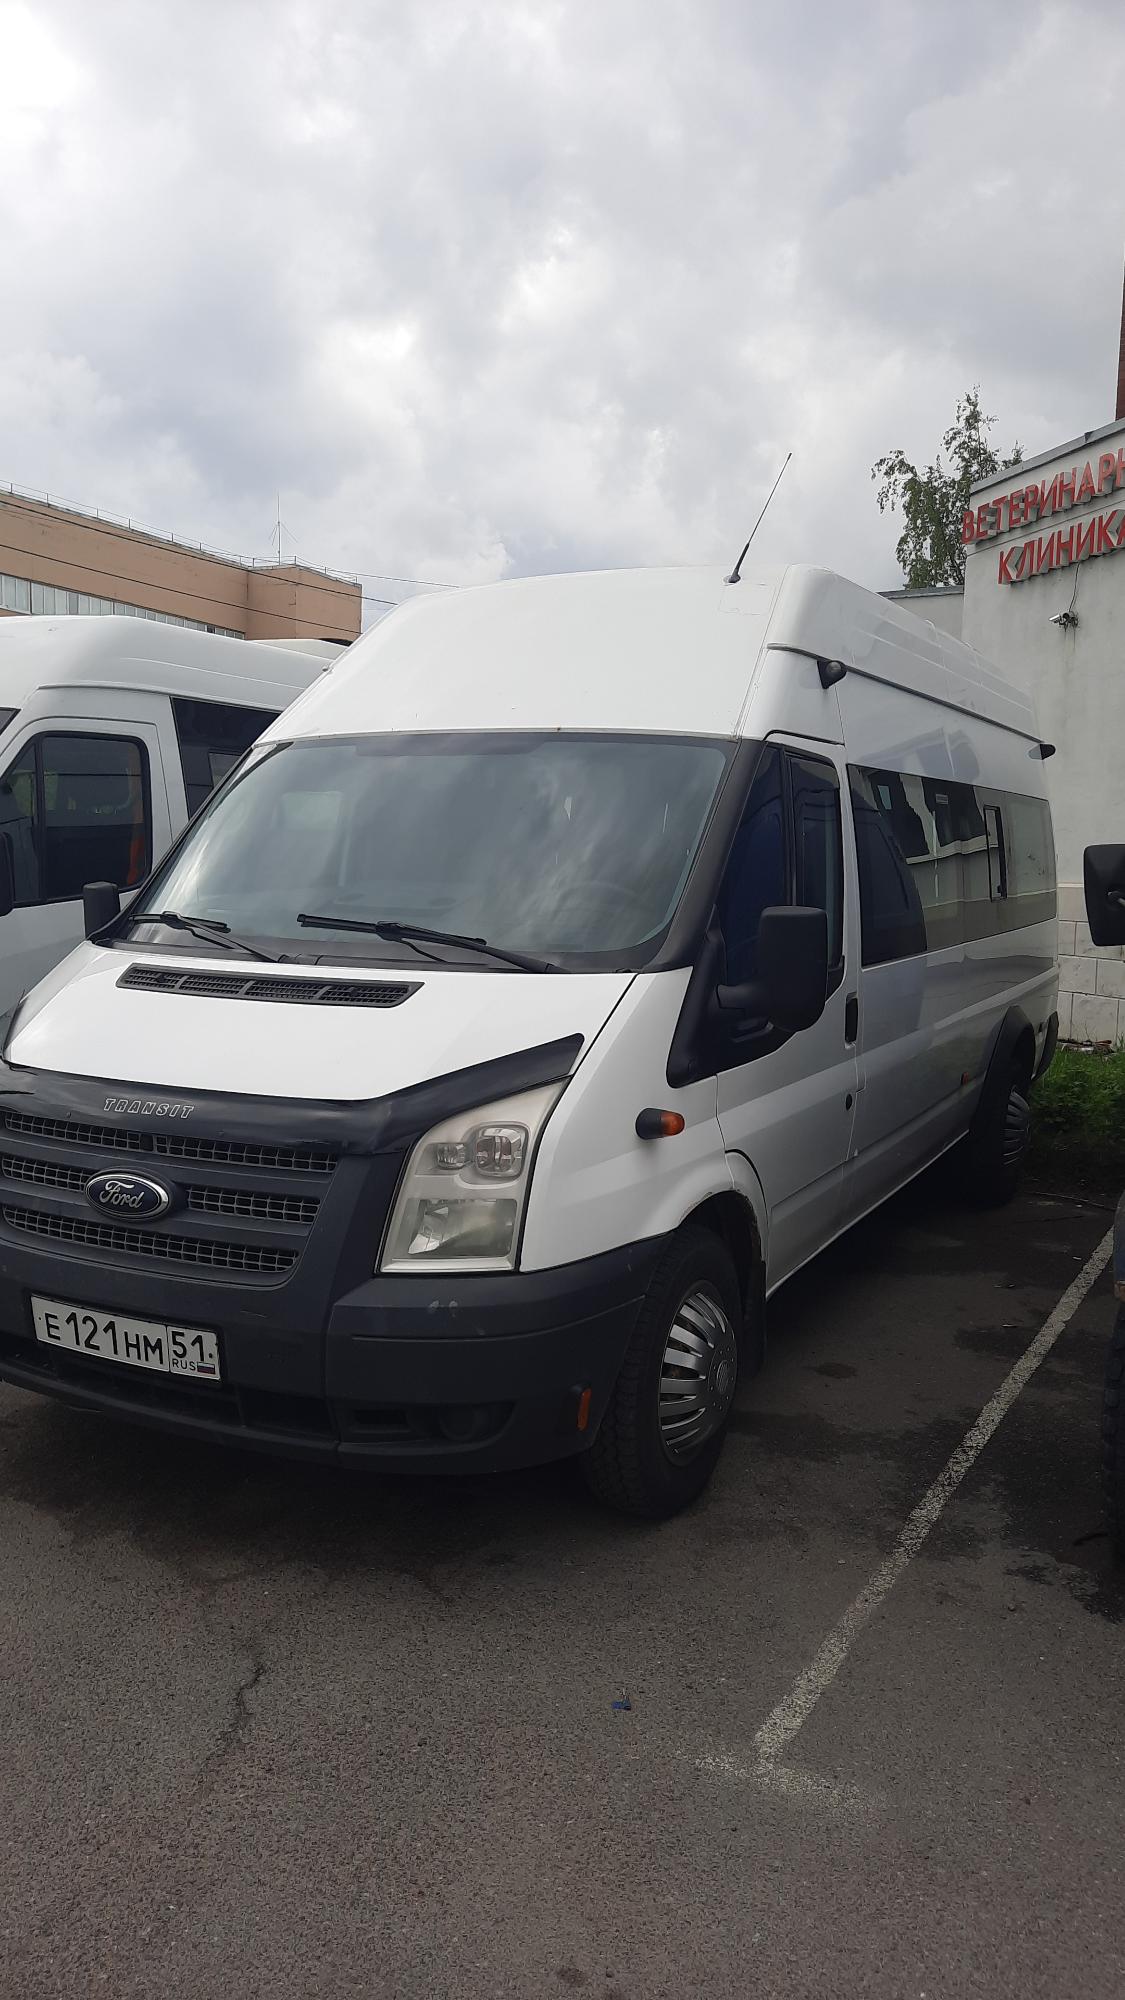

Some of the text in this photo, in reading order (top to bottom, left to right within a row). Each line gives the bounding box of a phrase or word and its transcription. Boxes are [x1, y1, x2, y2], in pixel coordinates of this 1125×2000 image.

[103, 1097, 195, 1119] TRANSIT
[99, 1180, 145, 1209] Ford
[171, 1330, 205, 1362] 51
[172, 1358, 196, 1372] RUS
